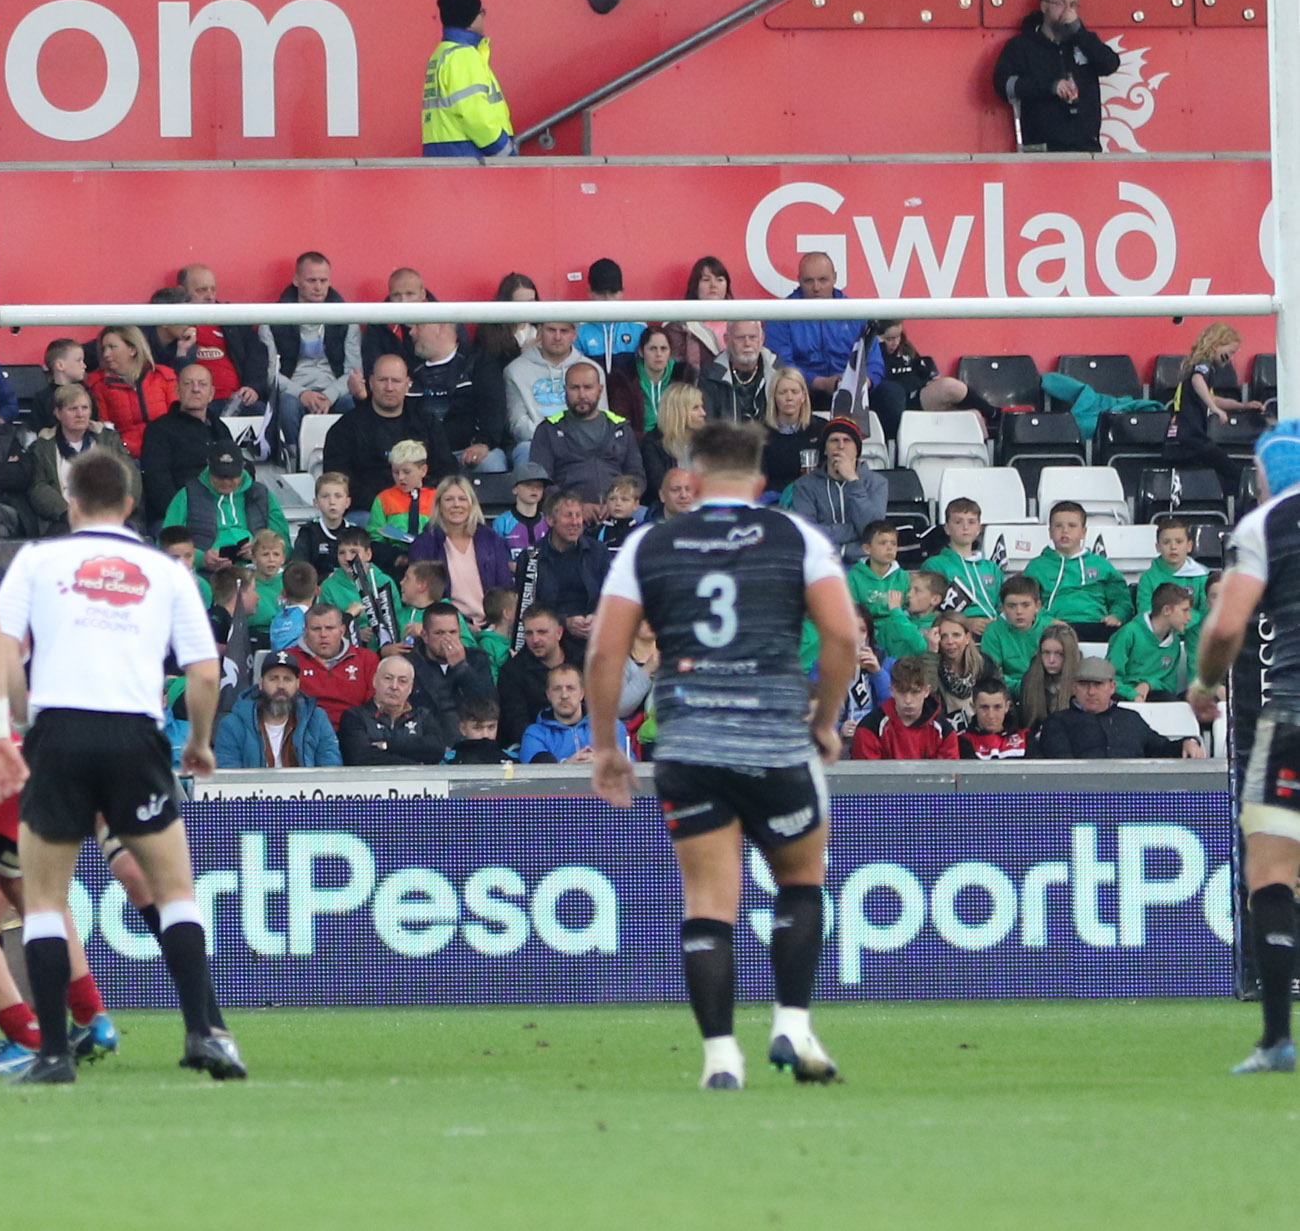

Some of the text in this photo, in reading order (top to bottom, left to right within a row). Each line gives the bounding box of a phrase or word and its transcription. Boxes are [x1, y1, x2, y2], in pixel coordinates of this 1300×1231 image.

[78, 578, 147, 597] red cloud
[101, 567, 125, 582] big
[692, 572, 739, 649] 3
[69, 828, 621, 960] ortPesa
